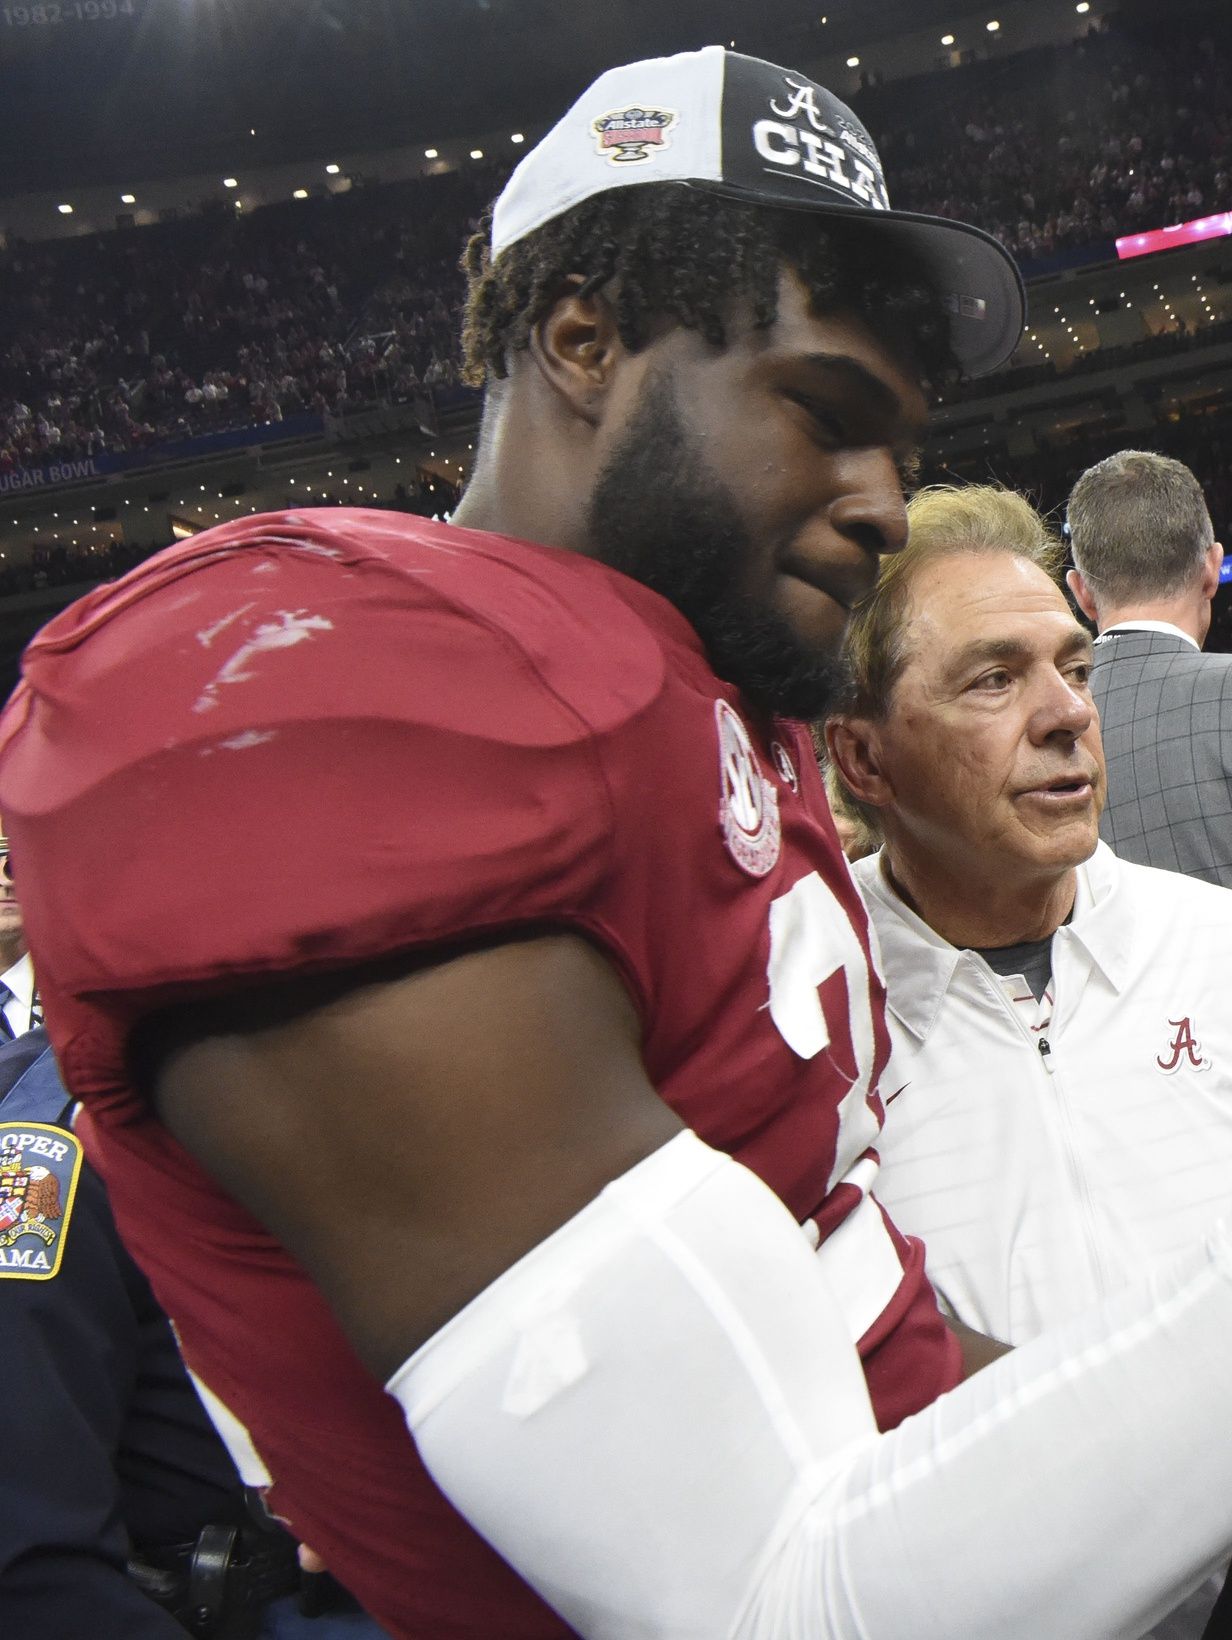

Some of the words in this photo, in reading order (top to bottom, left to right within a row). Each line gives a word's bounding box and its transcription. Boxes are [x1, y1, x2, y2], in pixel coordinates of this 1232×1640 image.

[604, 119, 661, 130] Allstate
[752, 120, 891, 211] CHA
[49, 460, 97, 480] BOWL
